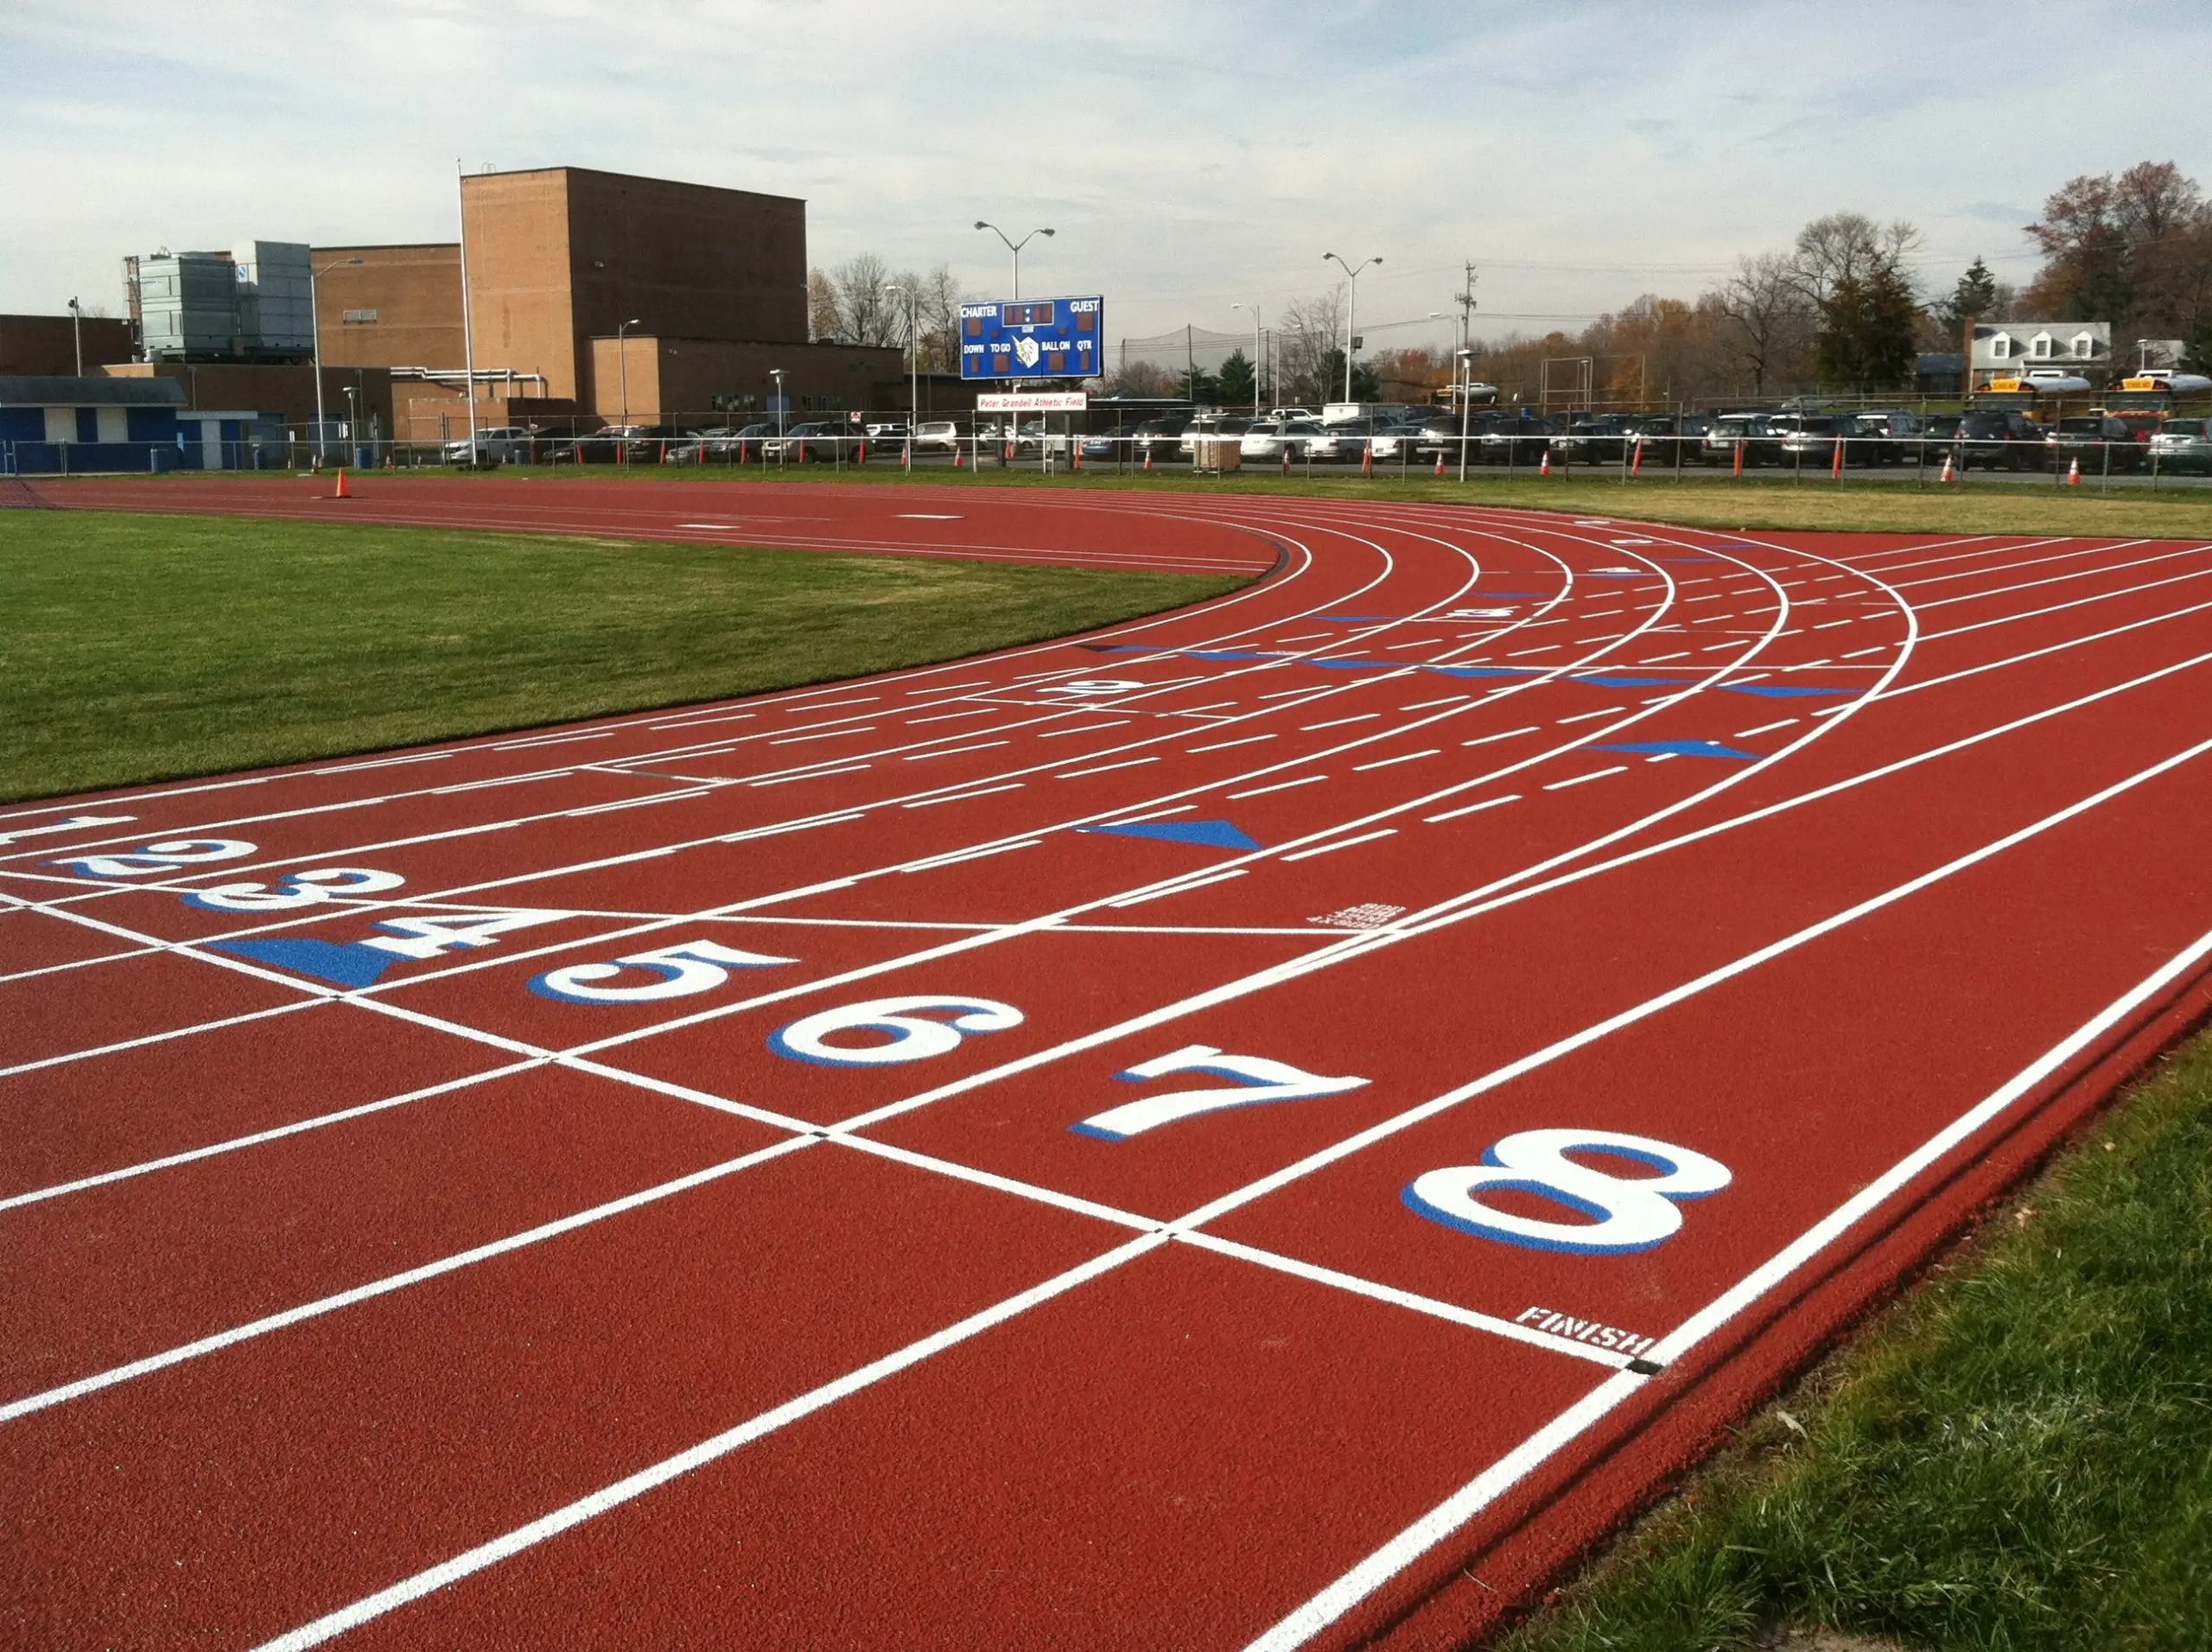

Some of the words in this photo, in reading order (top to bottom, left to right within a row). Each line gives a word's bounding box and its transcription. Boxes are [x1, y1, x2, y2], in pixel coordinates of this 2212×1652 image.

[961, 306, 997, 318] CHARTER
[1071, 300, 1099, 313] GUEST
[963, 344, 984, 354] DOWN
[989, 344, 1000, 353] TO
[1001, 343, 1011, 353] GO
[1041, 341, 1058, 351] BALL
[1059, 340, 1071, 350] ON
[1077, 340, 1092, 352] QTR
[980, 398, 999, 408] Peter
[1065, 397, 1084, 406] Field
[0, 816, 138, 846] 1
[41, 839, 257, 878] 2
[181, 867, 405, 912] 3
[354, 910, 582, 959] 4
[527, 939, 801, 1005] 5
[766, 994, 1025, 1067] 6
[1068, 1044, 1373, 1141] 7
[1401, 1128, 1733, 1255] 8
[1516, 1306, 1656, 1355] FINISH
